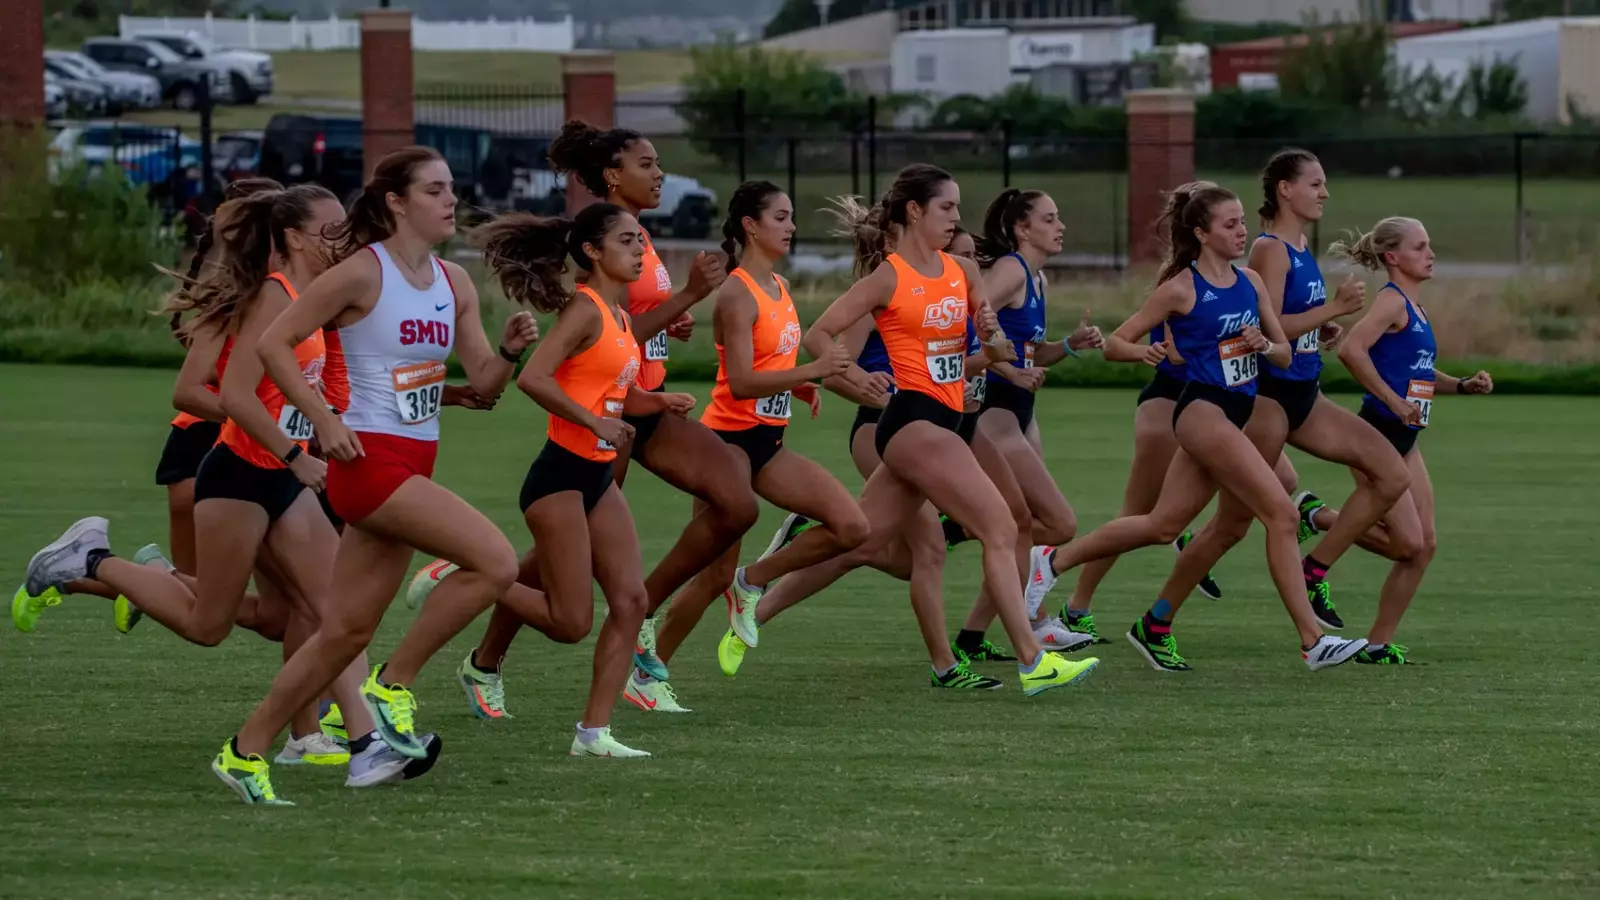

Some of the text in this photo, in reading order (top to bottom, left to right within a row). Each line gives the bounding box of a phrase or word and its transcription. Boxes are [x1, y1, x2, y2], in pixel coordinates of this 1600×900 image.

[923, 296, 966, 329] OSU
[1217, 310, 1260, 338] Tuls
[399, 318, 449, 348] SMU
[1303, 330, 1319, 349] 34
[1230, 353, 1257, 382] 346
[406, 385, 438, 420] 389
[762, 392, 790, 416] 358
